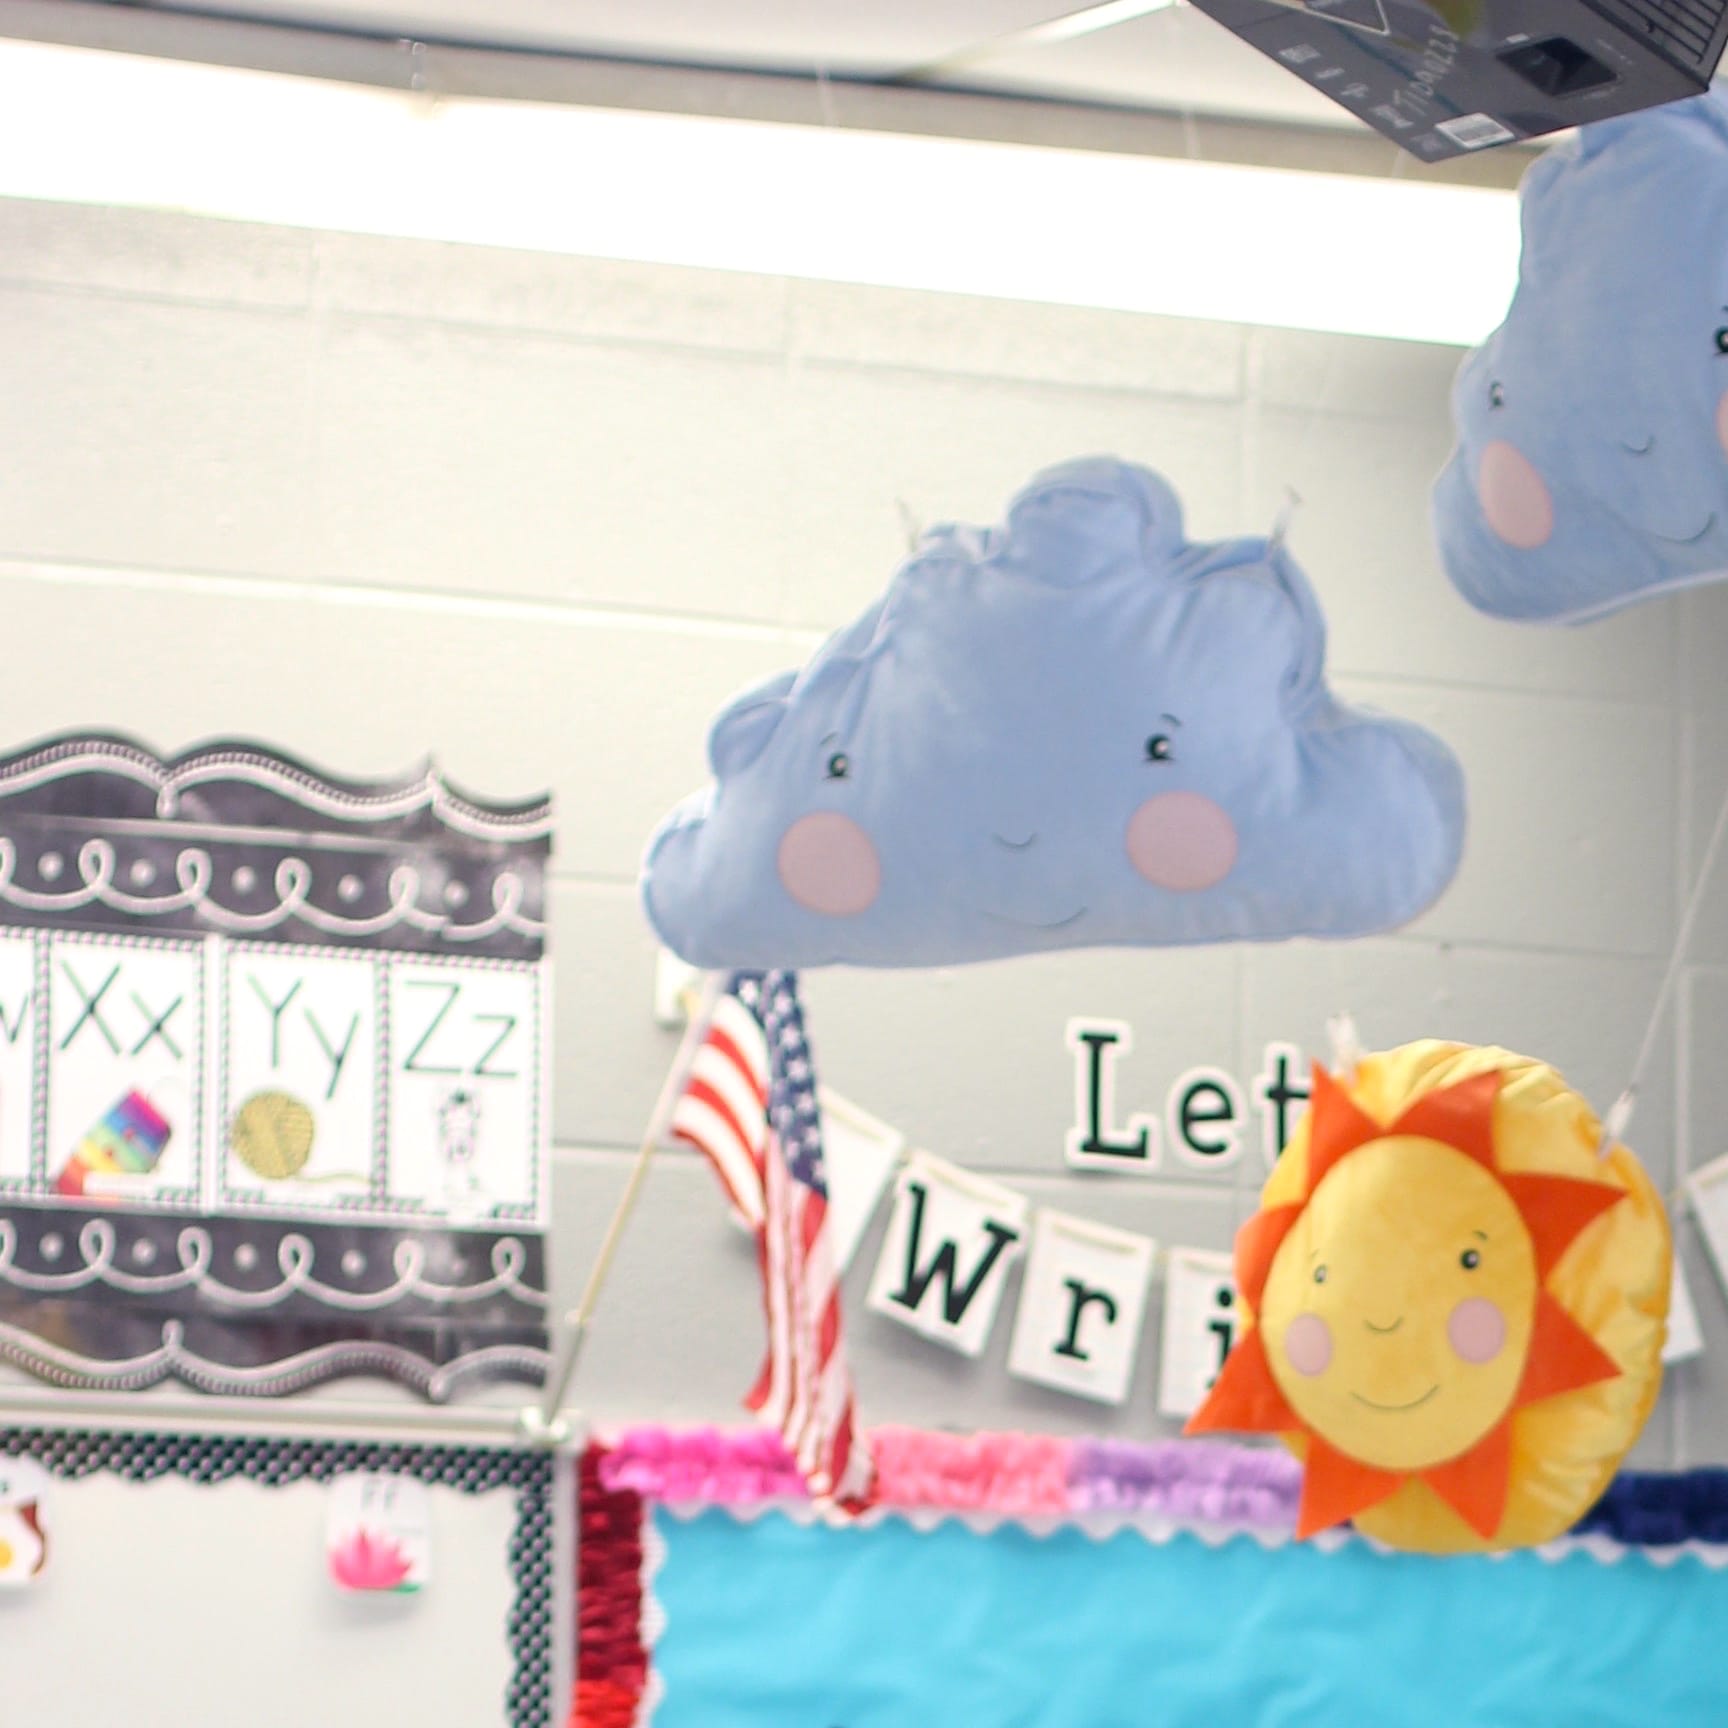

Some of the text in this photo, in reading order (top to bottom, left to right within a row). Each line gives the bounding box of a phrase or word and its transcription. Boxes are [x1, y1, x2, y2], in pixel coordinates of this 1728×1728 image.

[59, 961, 184, 1059] Xx
[246, 972, 361, 1100] Yy
[403, 978, 519, 1079] Zz
